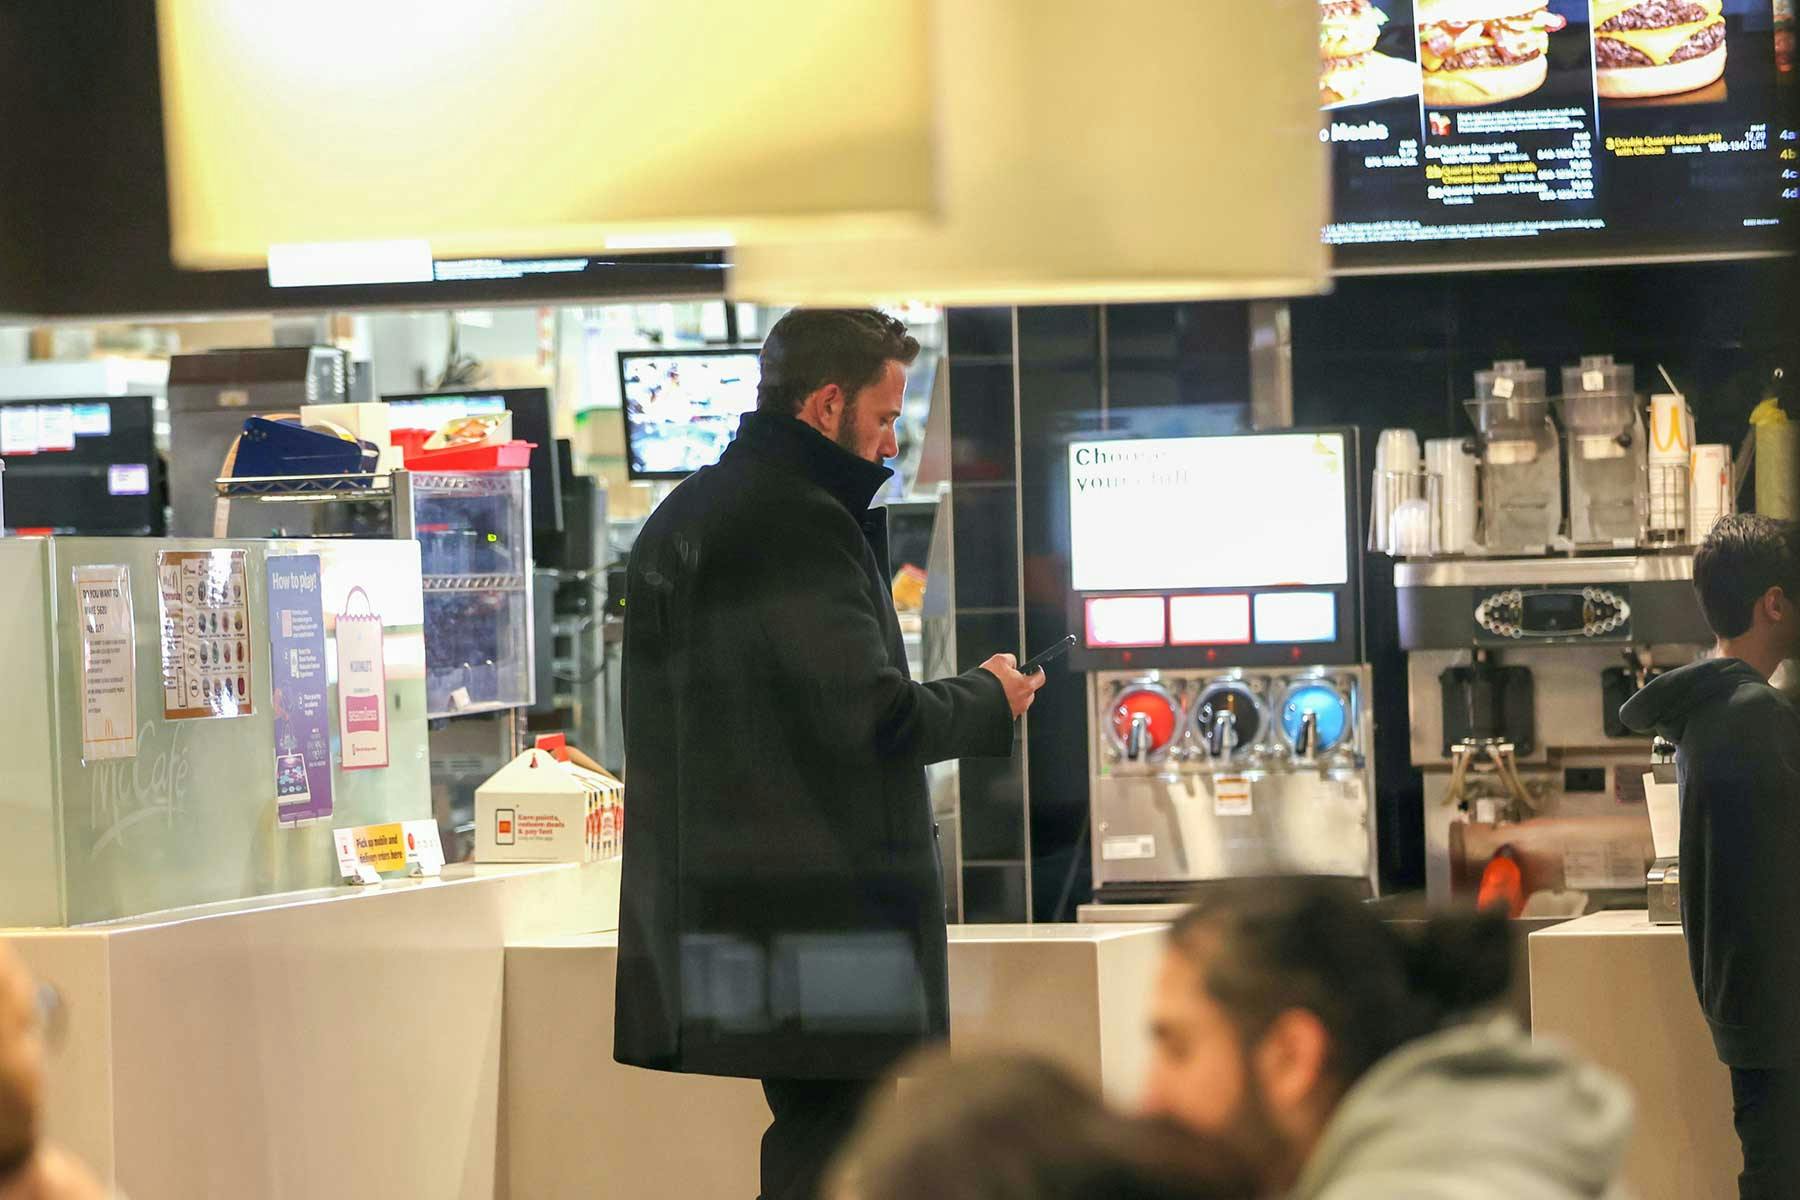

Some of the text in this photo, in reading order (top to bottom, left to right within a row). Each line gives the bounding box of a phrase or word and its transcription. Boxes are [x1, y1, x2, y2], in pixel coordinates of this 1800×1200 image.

[1779, 129, 1797, 141] 4a
[1780, 149, 1796, 160] 4b
[1781, 168, 1799, 179] 4c
[1075, 447, 1168, 466] Chooe
[272, 571, 317, 593] How to play!
[99, 588, 112, 598] WANT
[356, 837, 368, 848] Pick
[374, 835, 388, 847] mobile
[388, 833, 398, 845] and
[391, 849, 403, 860] here
